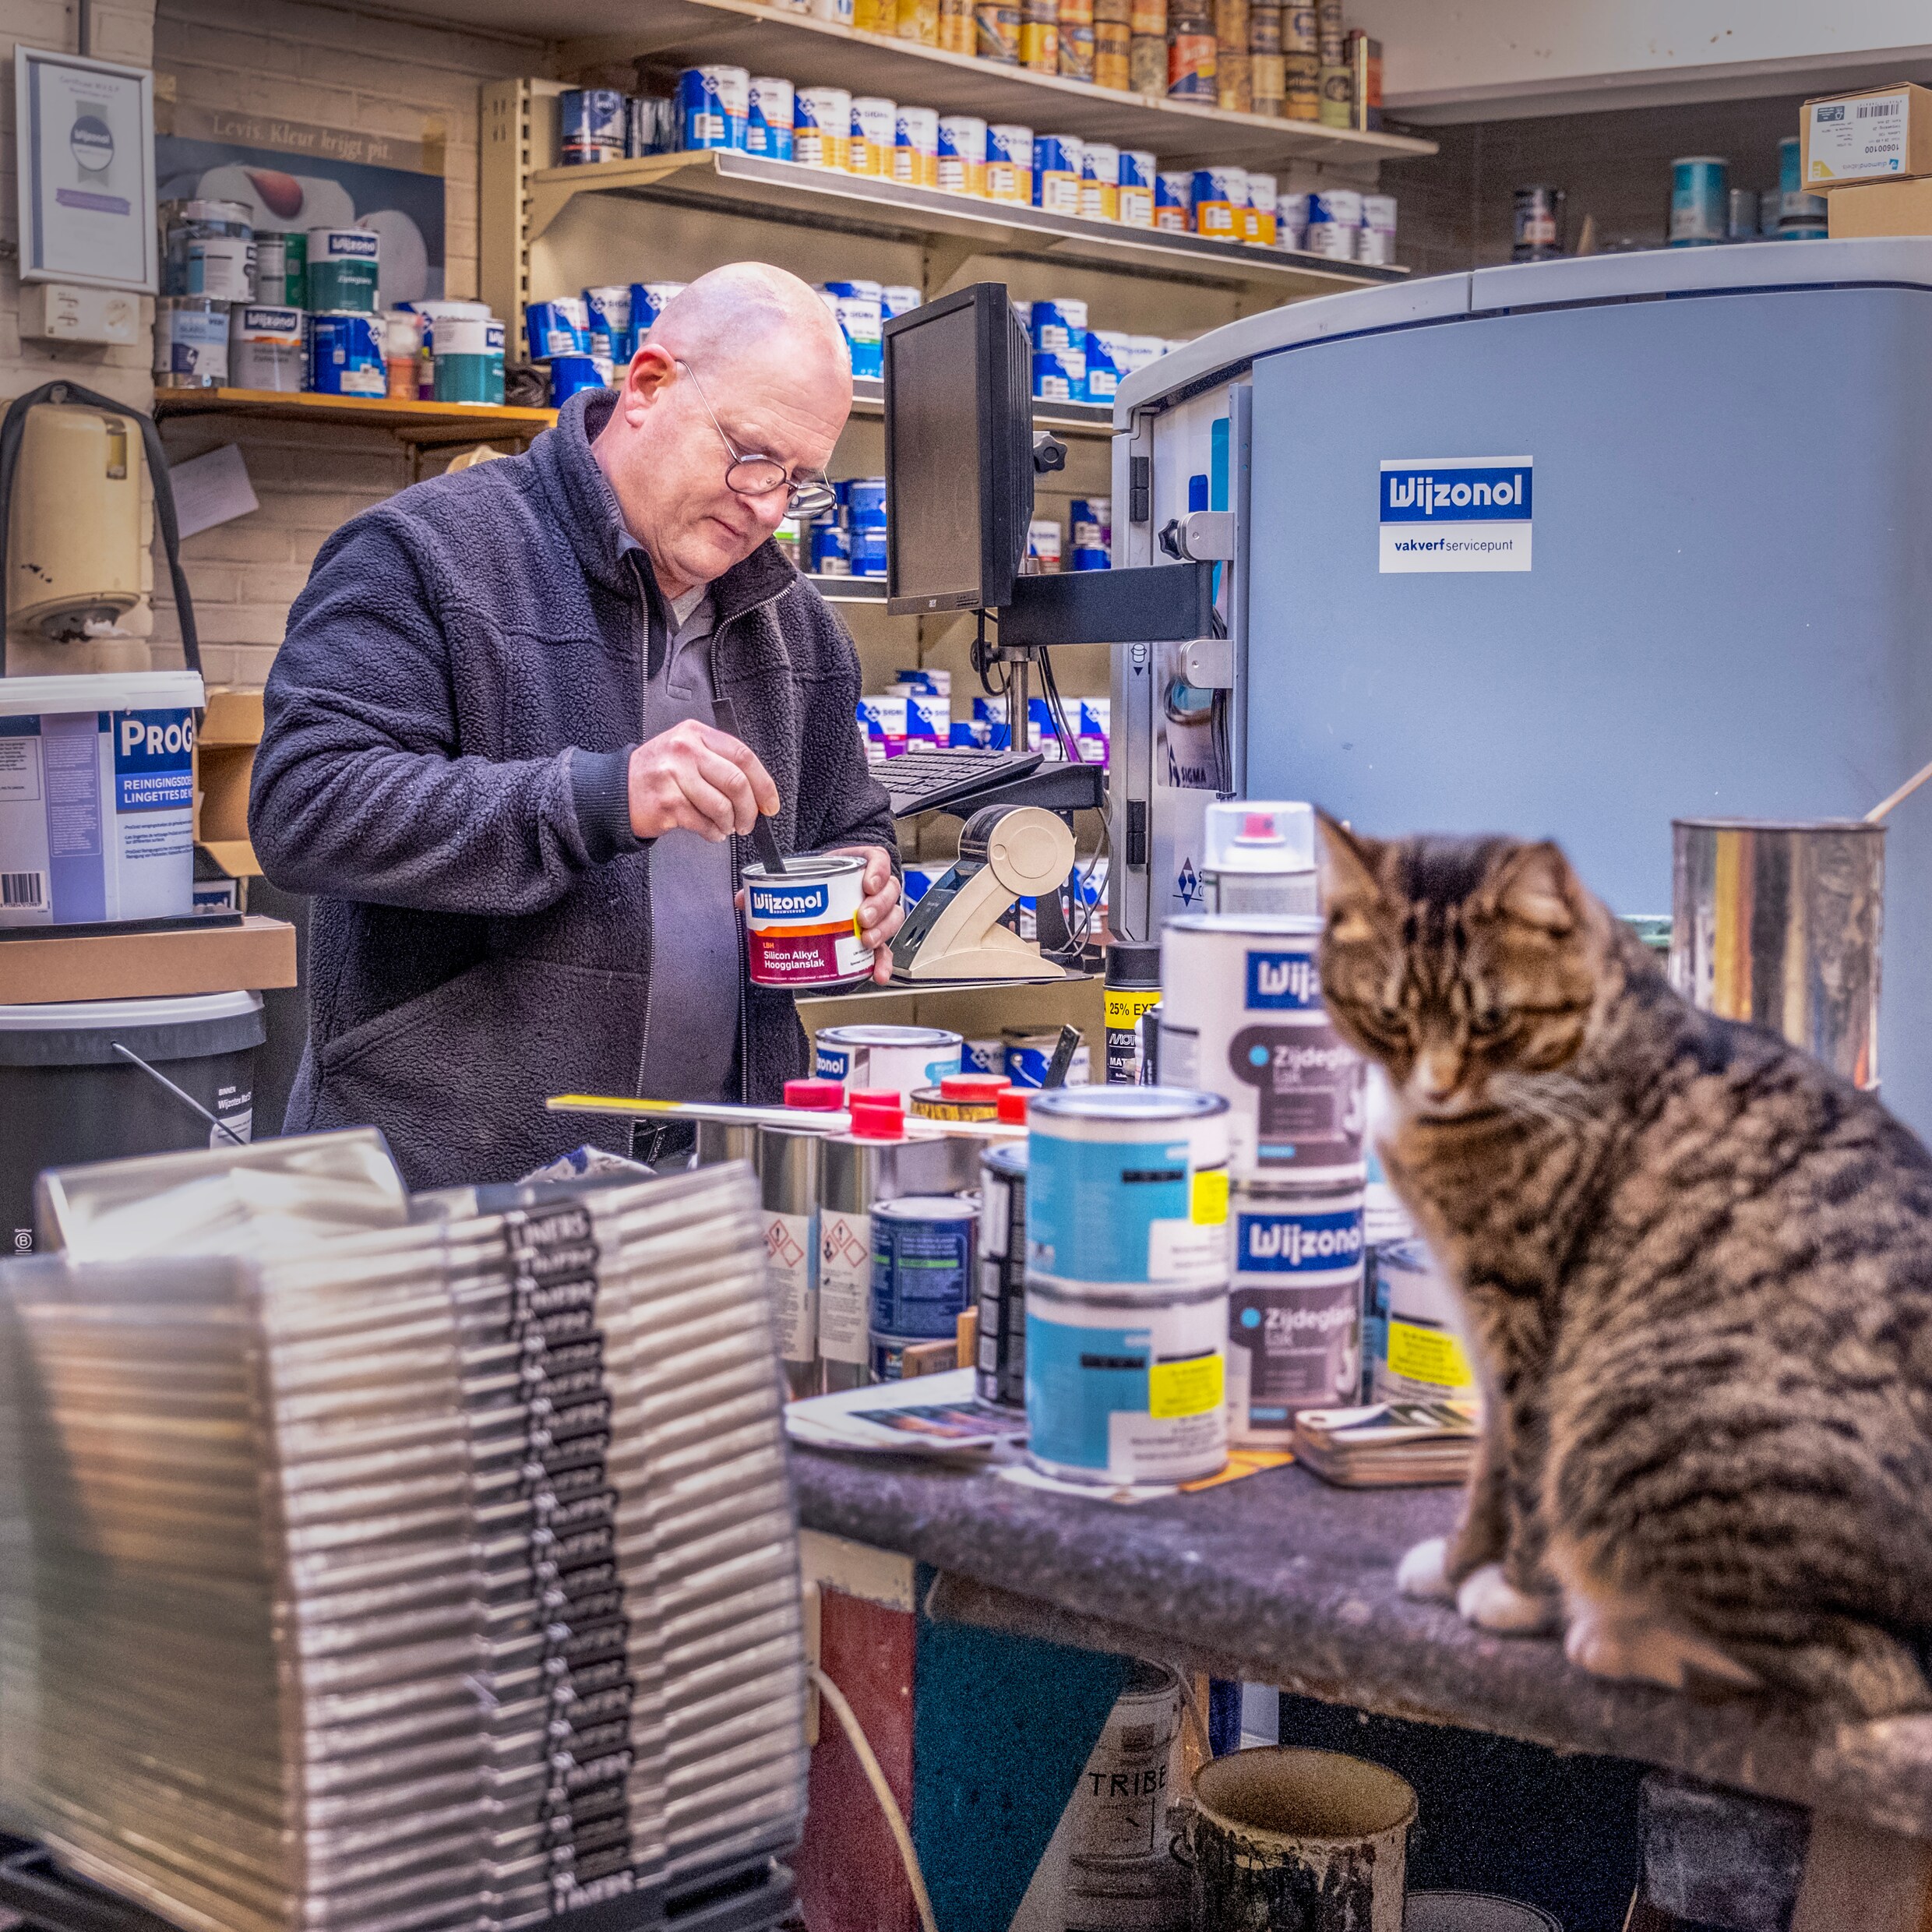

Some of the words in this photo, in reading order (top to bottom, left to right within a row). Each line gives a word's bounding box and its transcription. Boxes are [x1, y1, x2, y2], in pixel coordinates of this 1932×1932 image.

[1864, 143, 1899, 154] 10600100
[1390, 474, 1522, 515] Wijzonol
[1181, 766, 1207, 784] SIGMA
[125, 790, 180, 804] LINGETTES
[753, 890, 822, 914] Wijzonol
[763, 950, 791, 960] Silicon
[792, 950, 819, 962] Alkyd
[764, 959, 825, 971] Hoogglanslak
[1109, 1002, 1130, 1016] 25%
[1088, 1764, 1167, 1798] TRIBE
